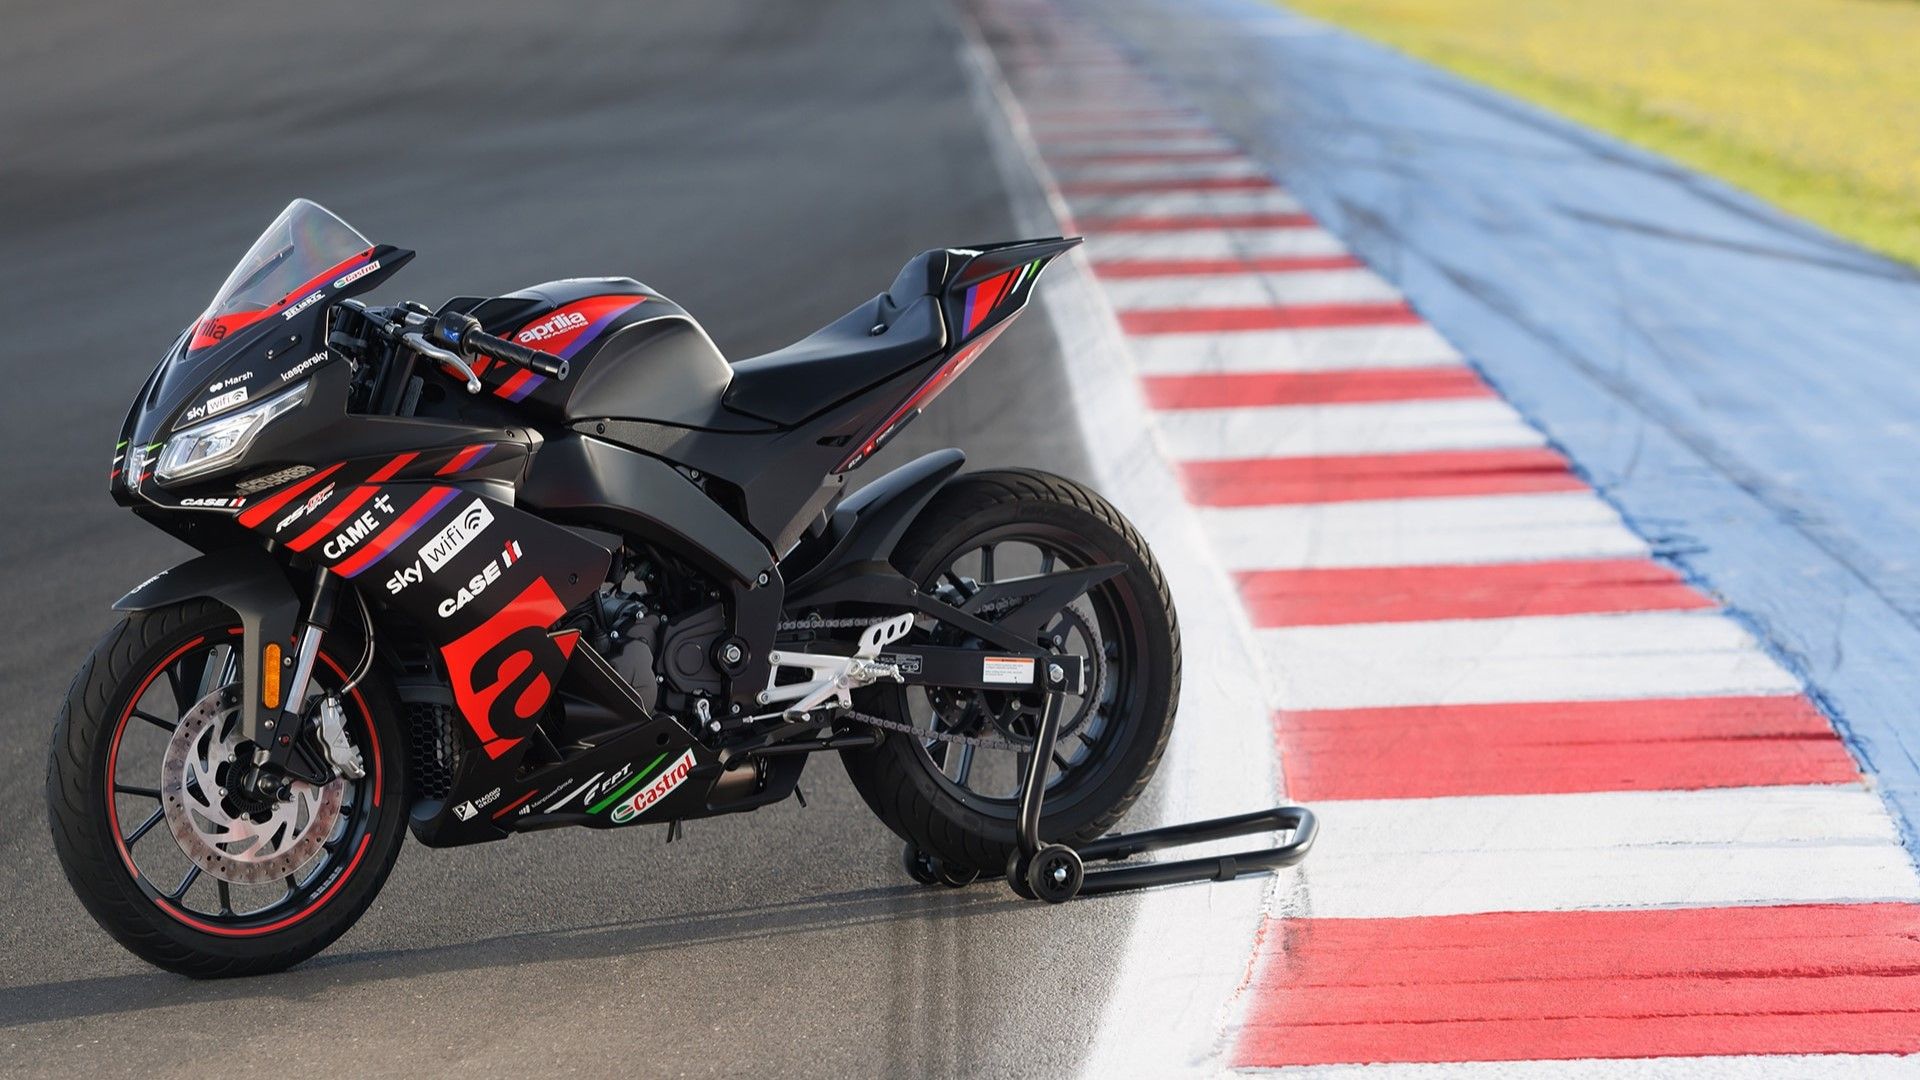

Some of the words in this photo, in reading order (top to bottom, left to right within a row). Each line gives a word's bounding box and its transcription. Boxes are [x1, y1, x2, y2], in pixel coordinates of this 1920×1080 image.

[518, 311, 587, 343] aprilia
[224, 371, 253, 387] Marsh
[280, 350, 329, 382] kaspersky
[186, 404, 207, 420] sky
[180, 498, 229, 507] CASE
[323, 511, 380, 560] CAME
[386, 560, 424, 595] sky
[427, 524, 464, 563] wifi
[437, 560, 502, 619] CASE
[601, 762, 632, 792] FPT
[632, 754, 694, 812] Castrol
